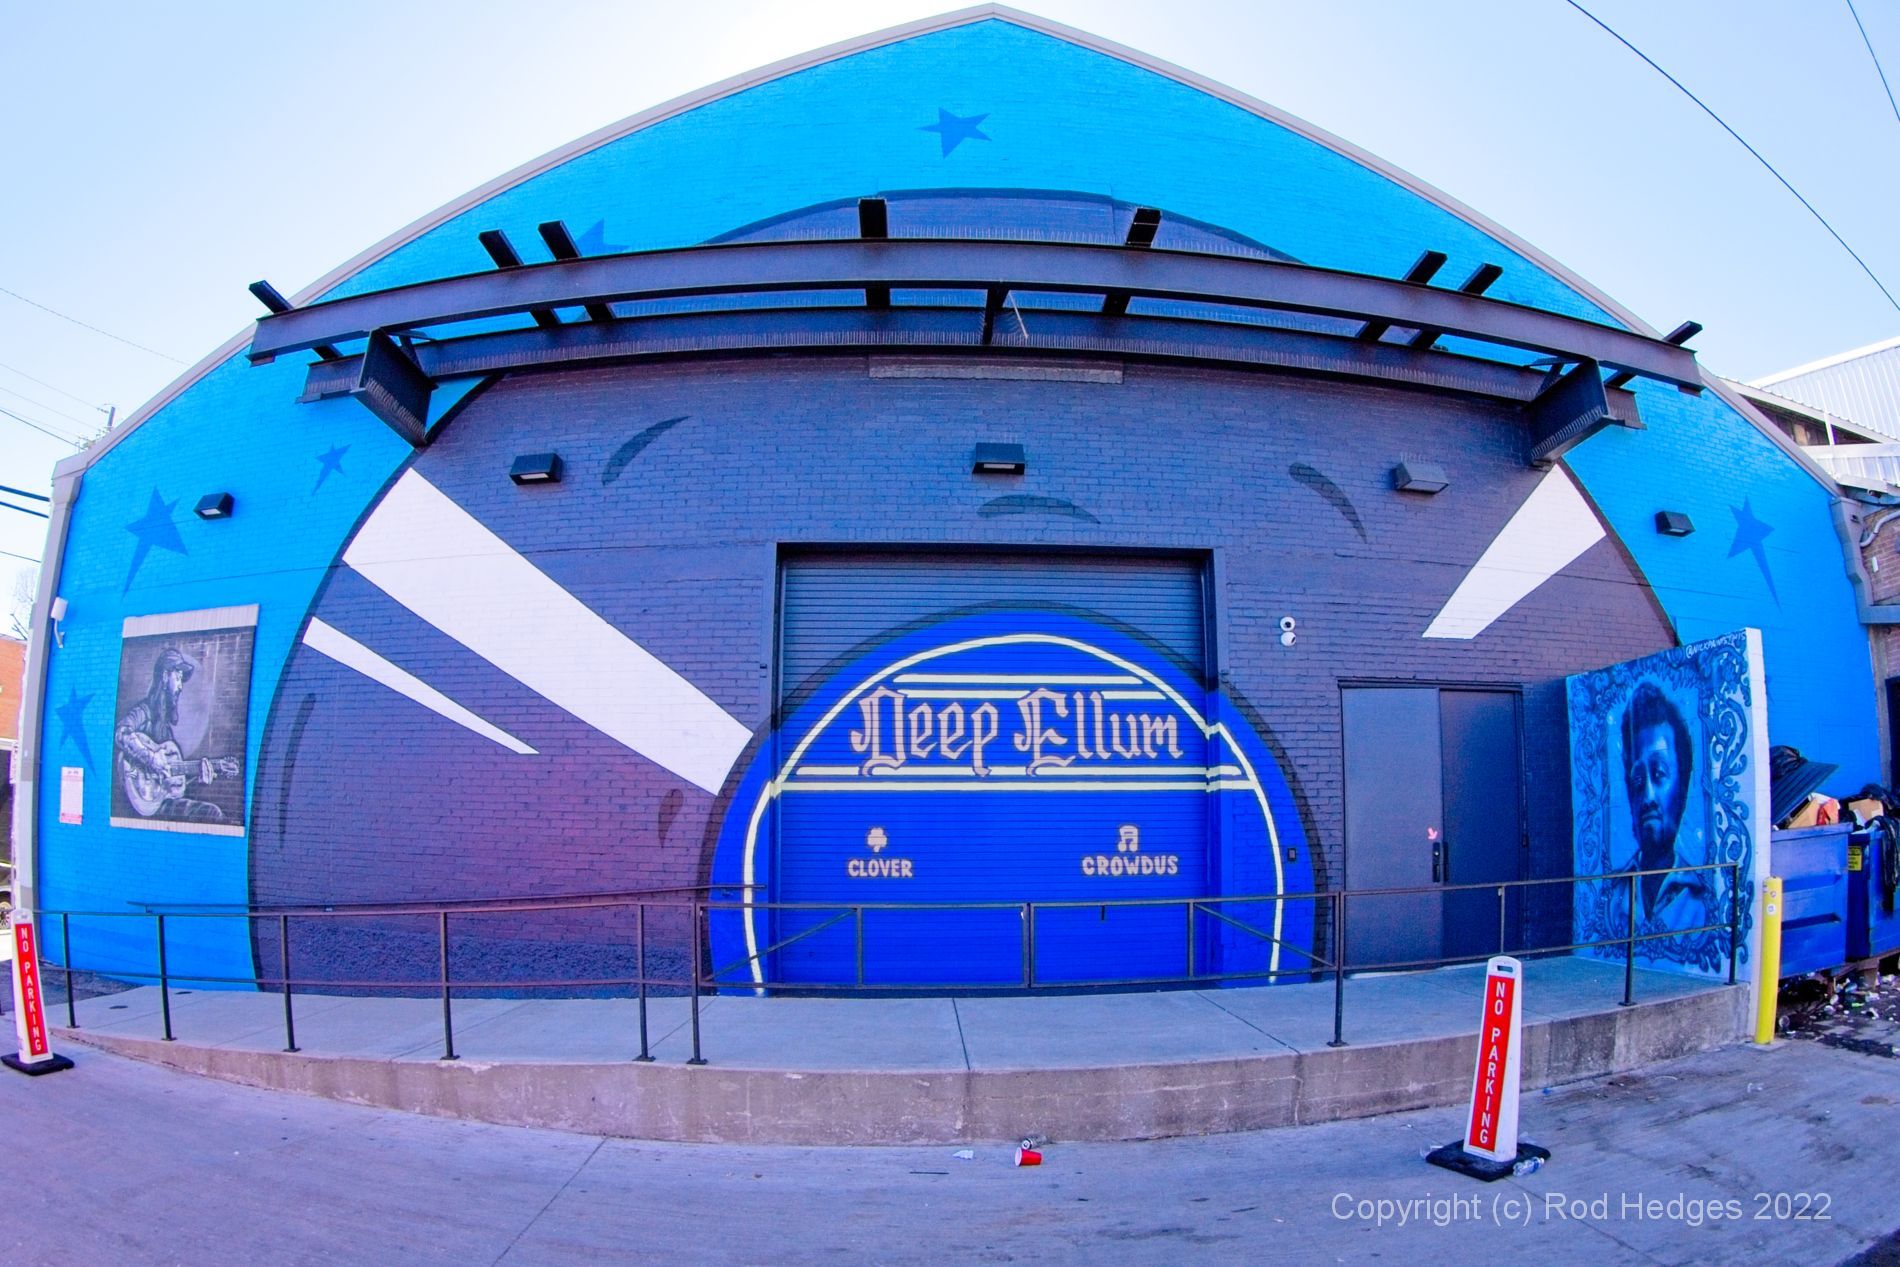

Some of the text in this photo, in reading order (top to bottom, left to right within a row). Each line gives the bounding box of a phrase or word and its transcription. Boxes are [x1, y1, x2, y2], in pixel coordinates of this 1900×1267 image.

[850, 686, 1184, 777] Deep Ellum
[847, 858, 913, 878] CLOVER
[1081, 855, 1179, 876] CROWDUS
[20, 927, 42, 1051] NO PARKING
[1479, 981, 1506, 1144] NO PARKING
